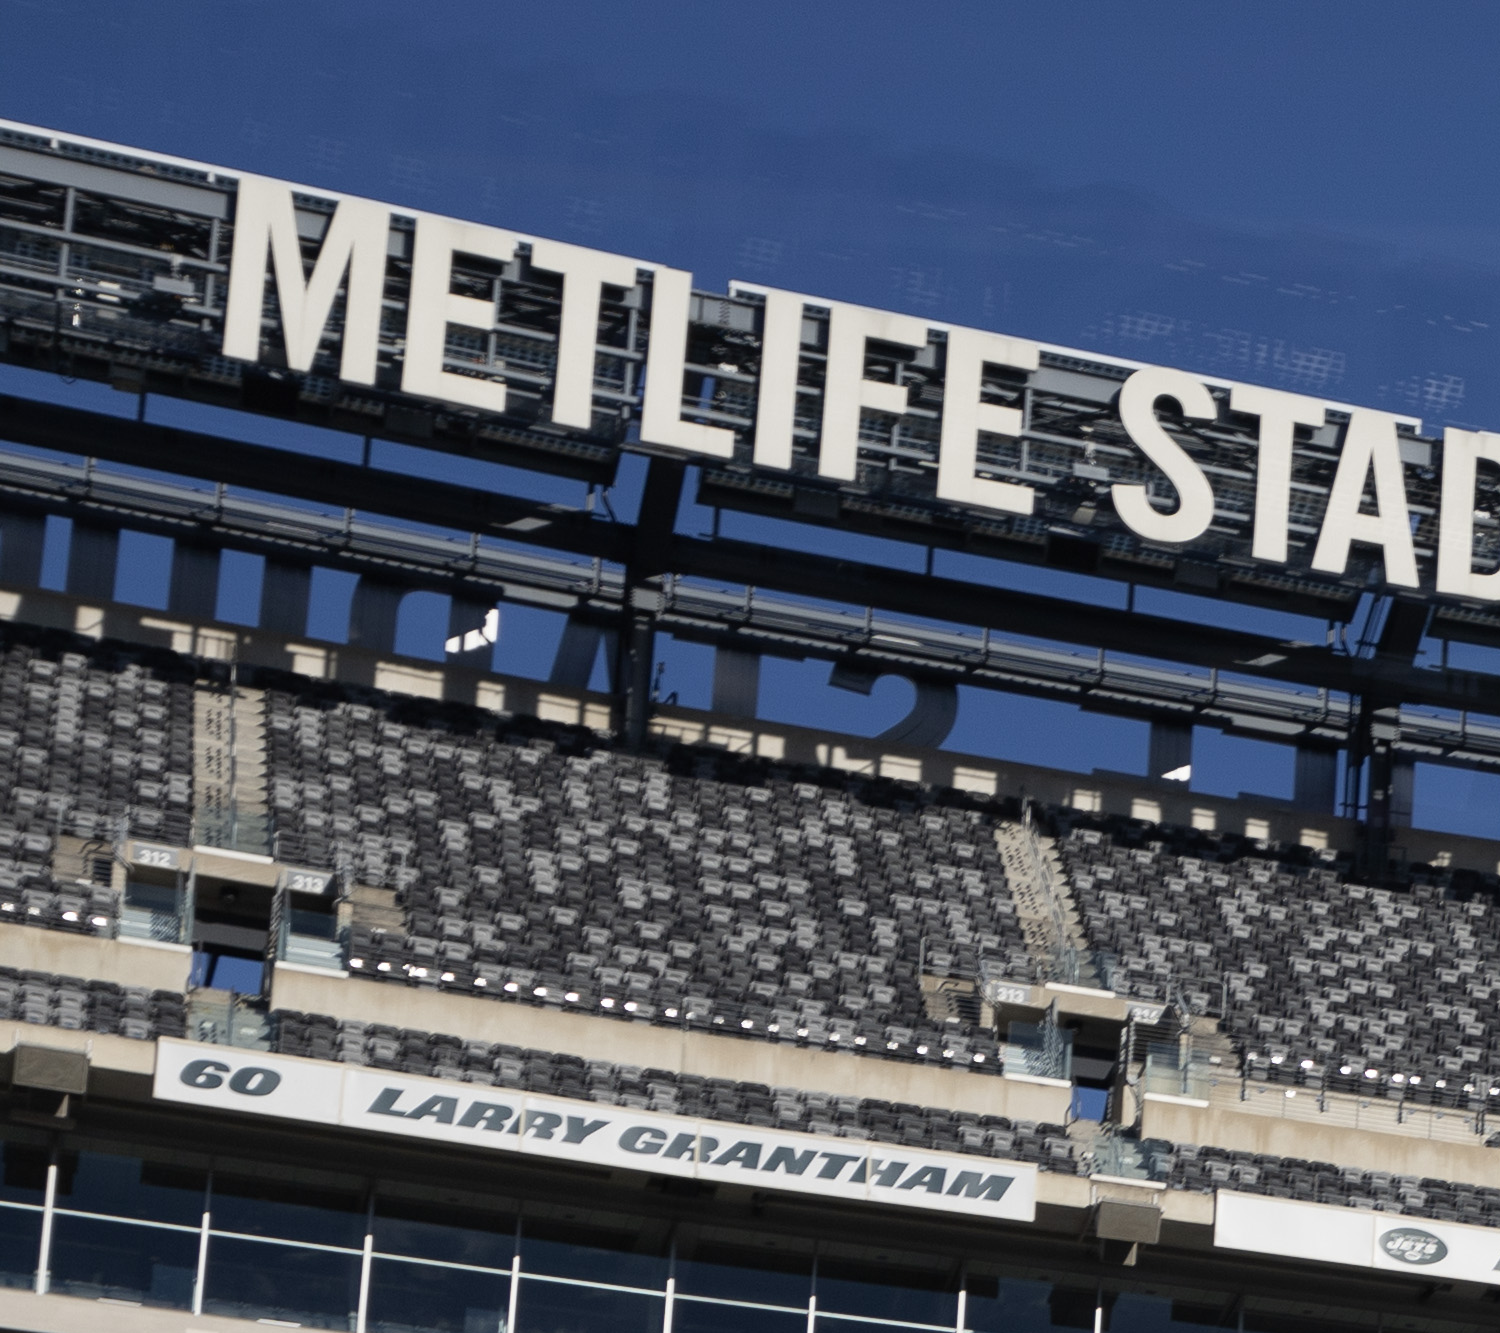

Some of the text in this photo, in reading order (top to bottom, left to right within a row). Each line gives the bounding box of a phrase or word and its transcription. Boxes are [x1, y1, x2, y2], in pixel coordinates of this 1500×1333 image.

[221, 182, 1041, 515] METLIFE
[134, 846, 170, 865] 312
[291, 874, 323, 893] 313
[997, 987, 1026, 1004] 313
[178, 1058, 1017, 1202] 60 LARRY GRANTHAM
